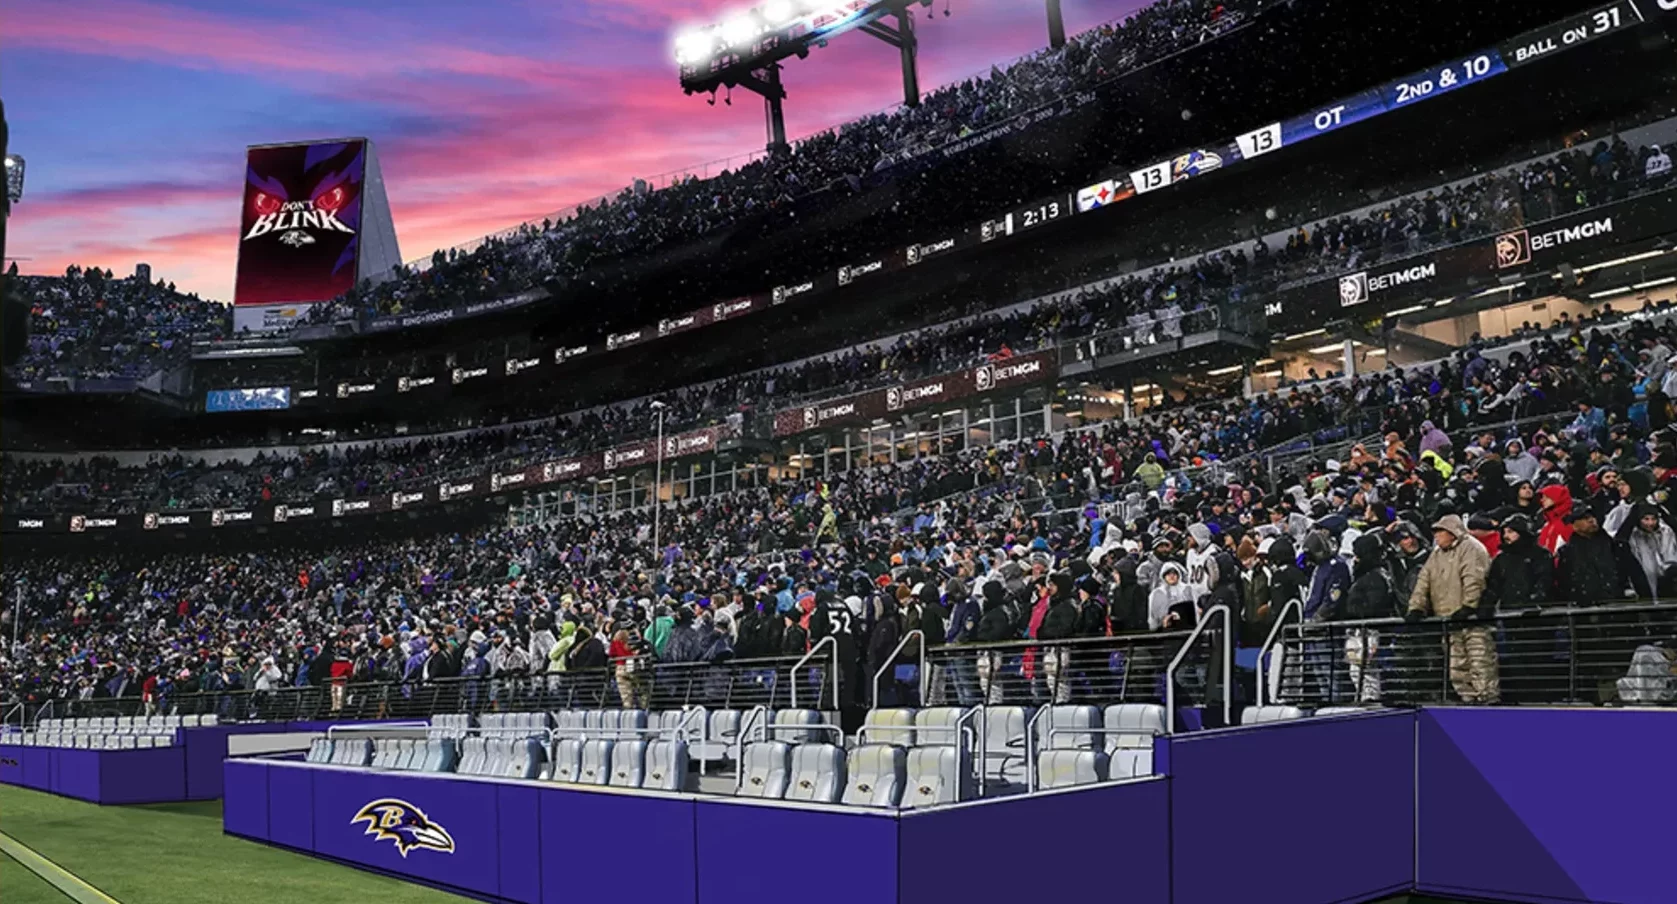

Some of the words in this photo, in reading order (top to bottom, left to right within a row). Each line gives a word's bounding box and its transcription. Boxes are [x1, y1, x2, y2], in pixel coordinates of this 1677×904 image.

[1516, 38, 1557, 61] BALL
[1562, 26, 1587, 44] ON
[1593, 7, 1620, 33] 31
[1396, 80, 1433, 103] 2ND
[1438, 68, 1457, 88] &
[1463, 55, 1490, 79] 10
[1314, 105, 1345, 130] OT
[1250, 130, 1274, 153] 13
[1142, 168, 1162, 189] 13
[243, 208, 356, 241] BLINK
[1023, 202, 1059, 226] 2:13
[1530, 217, 1613, 251] BETMGM
[1368, 263, 1436, 292] BETMGM
[994, 360, 1040, 380] BETMGM
[902, 383, 943, 401] BETMGM
[819, 404, 854, 420] BETMGM
[828, 610, 852, 634] 52
